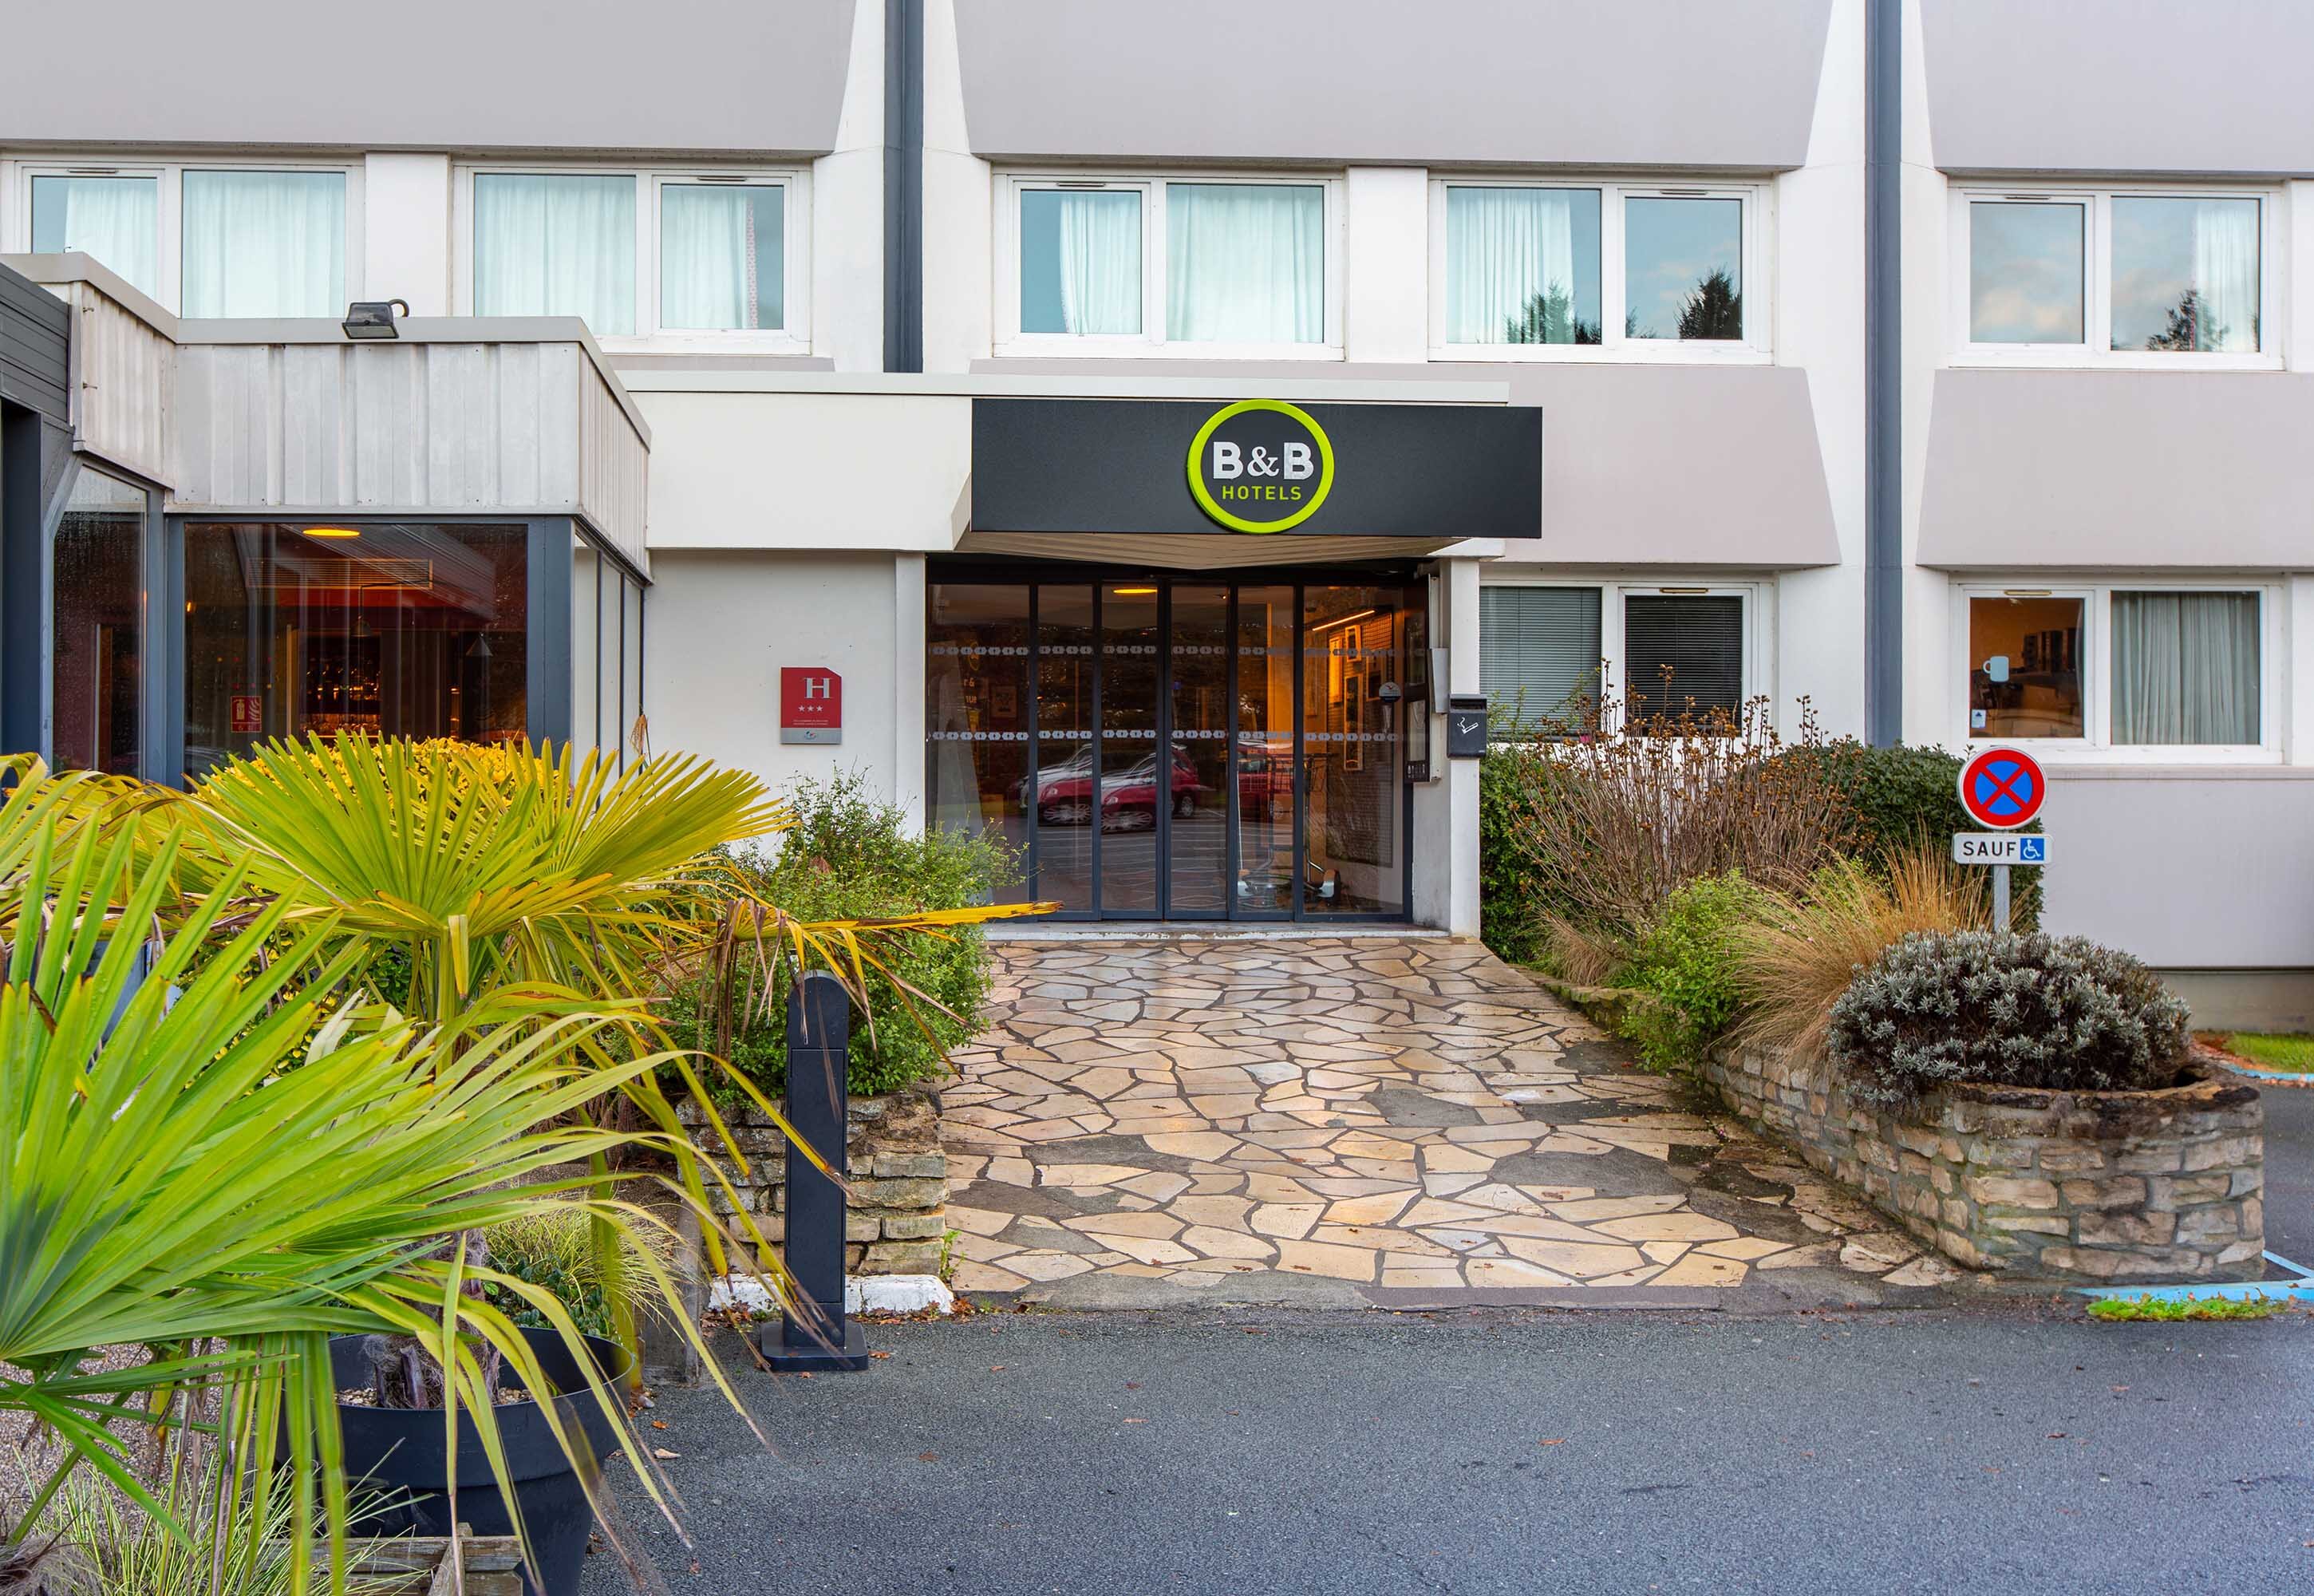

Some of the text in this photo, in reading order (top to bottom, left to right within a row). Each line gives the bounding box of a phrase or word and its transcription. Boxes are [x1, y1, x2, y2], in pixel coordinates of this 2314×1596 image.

[1213, 441, 1314, 480] B&B
[1222, 485, 1302, 500] HOTELS
[804, 677, 832, 699] H
[1963, 841, 2016, 856] SAUF
